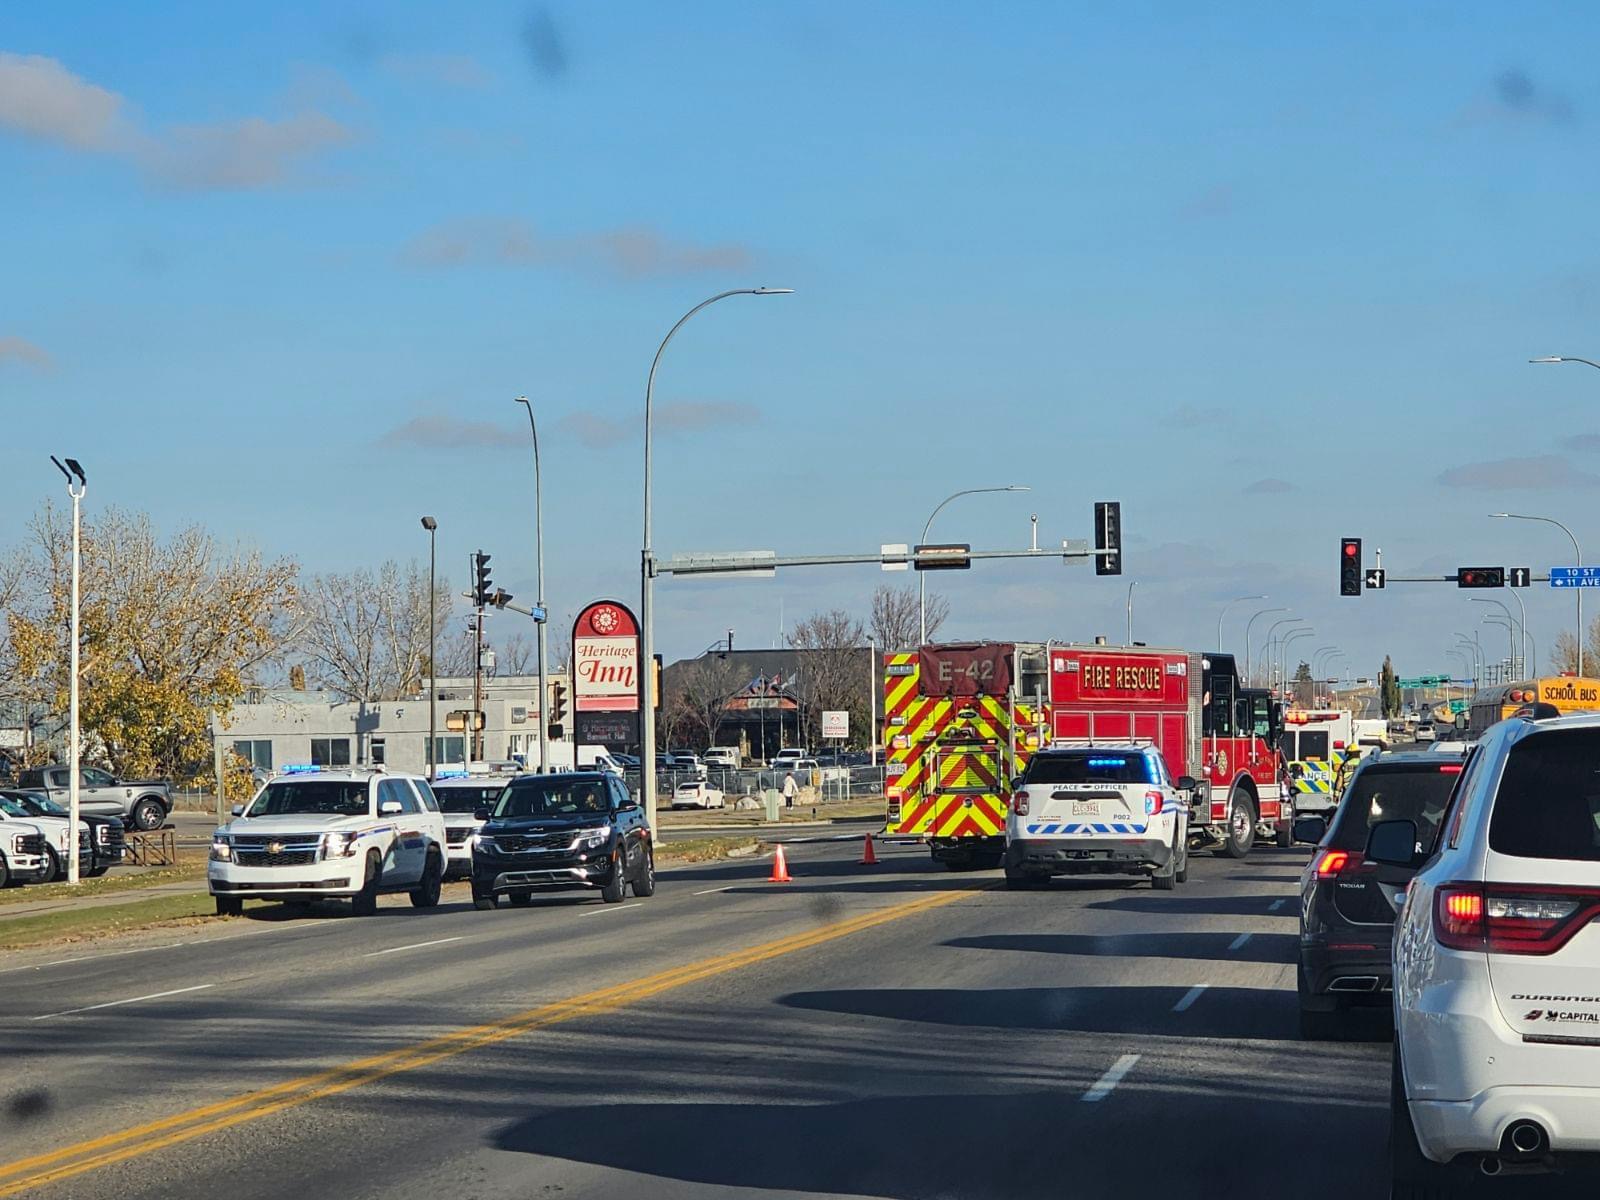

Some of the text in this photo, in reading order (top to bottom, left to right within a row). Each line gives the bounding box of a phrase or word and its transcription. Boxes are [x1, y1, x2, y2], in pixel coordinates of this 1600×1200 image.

[1566, 568, 1579, 577] 10
[1567, 578, 1600, 586] 11 AVE
[577, 644, 635, 660] Heritage
[578, 660, 635, 688] Inn
[939, 660, 994, 681] E-42
[1084, 665, 1161, 690] FIRE RESCUE
[1544, 686, 1598, 702] SCHOOL BUS
[1559, 1012, 1600, 1021] CAPITAL
